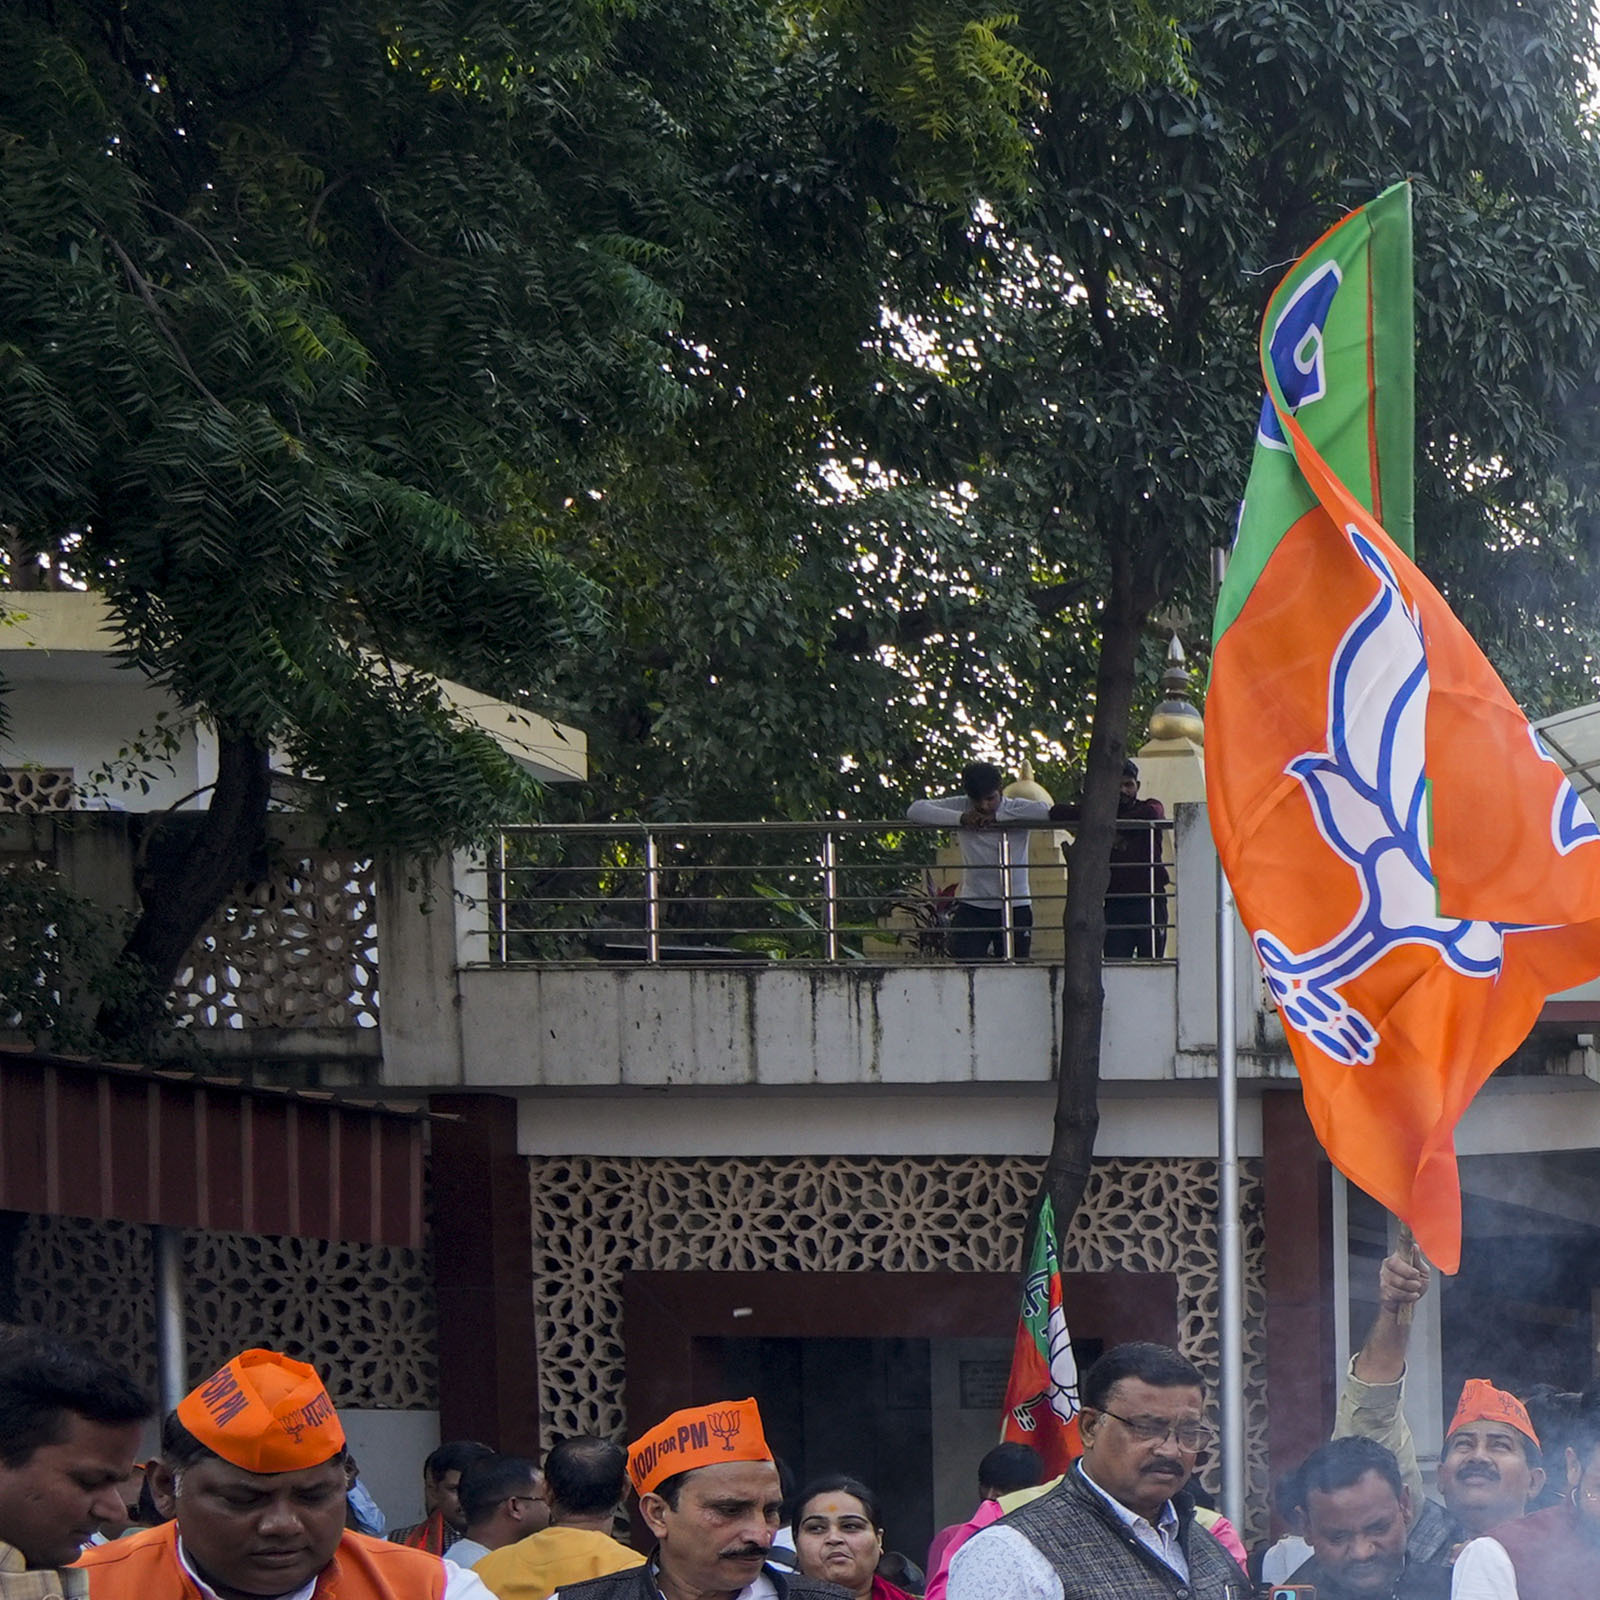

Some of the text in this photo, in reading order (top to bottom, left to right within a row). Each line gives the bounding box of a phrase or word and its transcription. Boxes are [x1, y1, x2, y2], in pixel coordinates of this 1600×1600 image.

[200, 1366, 249, 1428] FOR PM
[658, 1436, 677, 1458] FOR
[677, 1421, 709, 1453] PM
